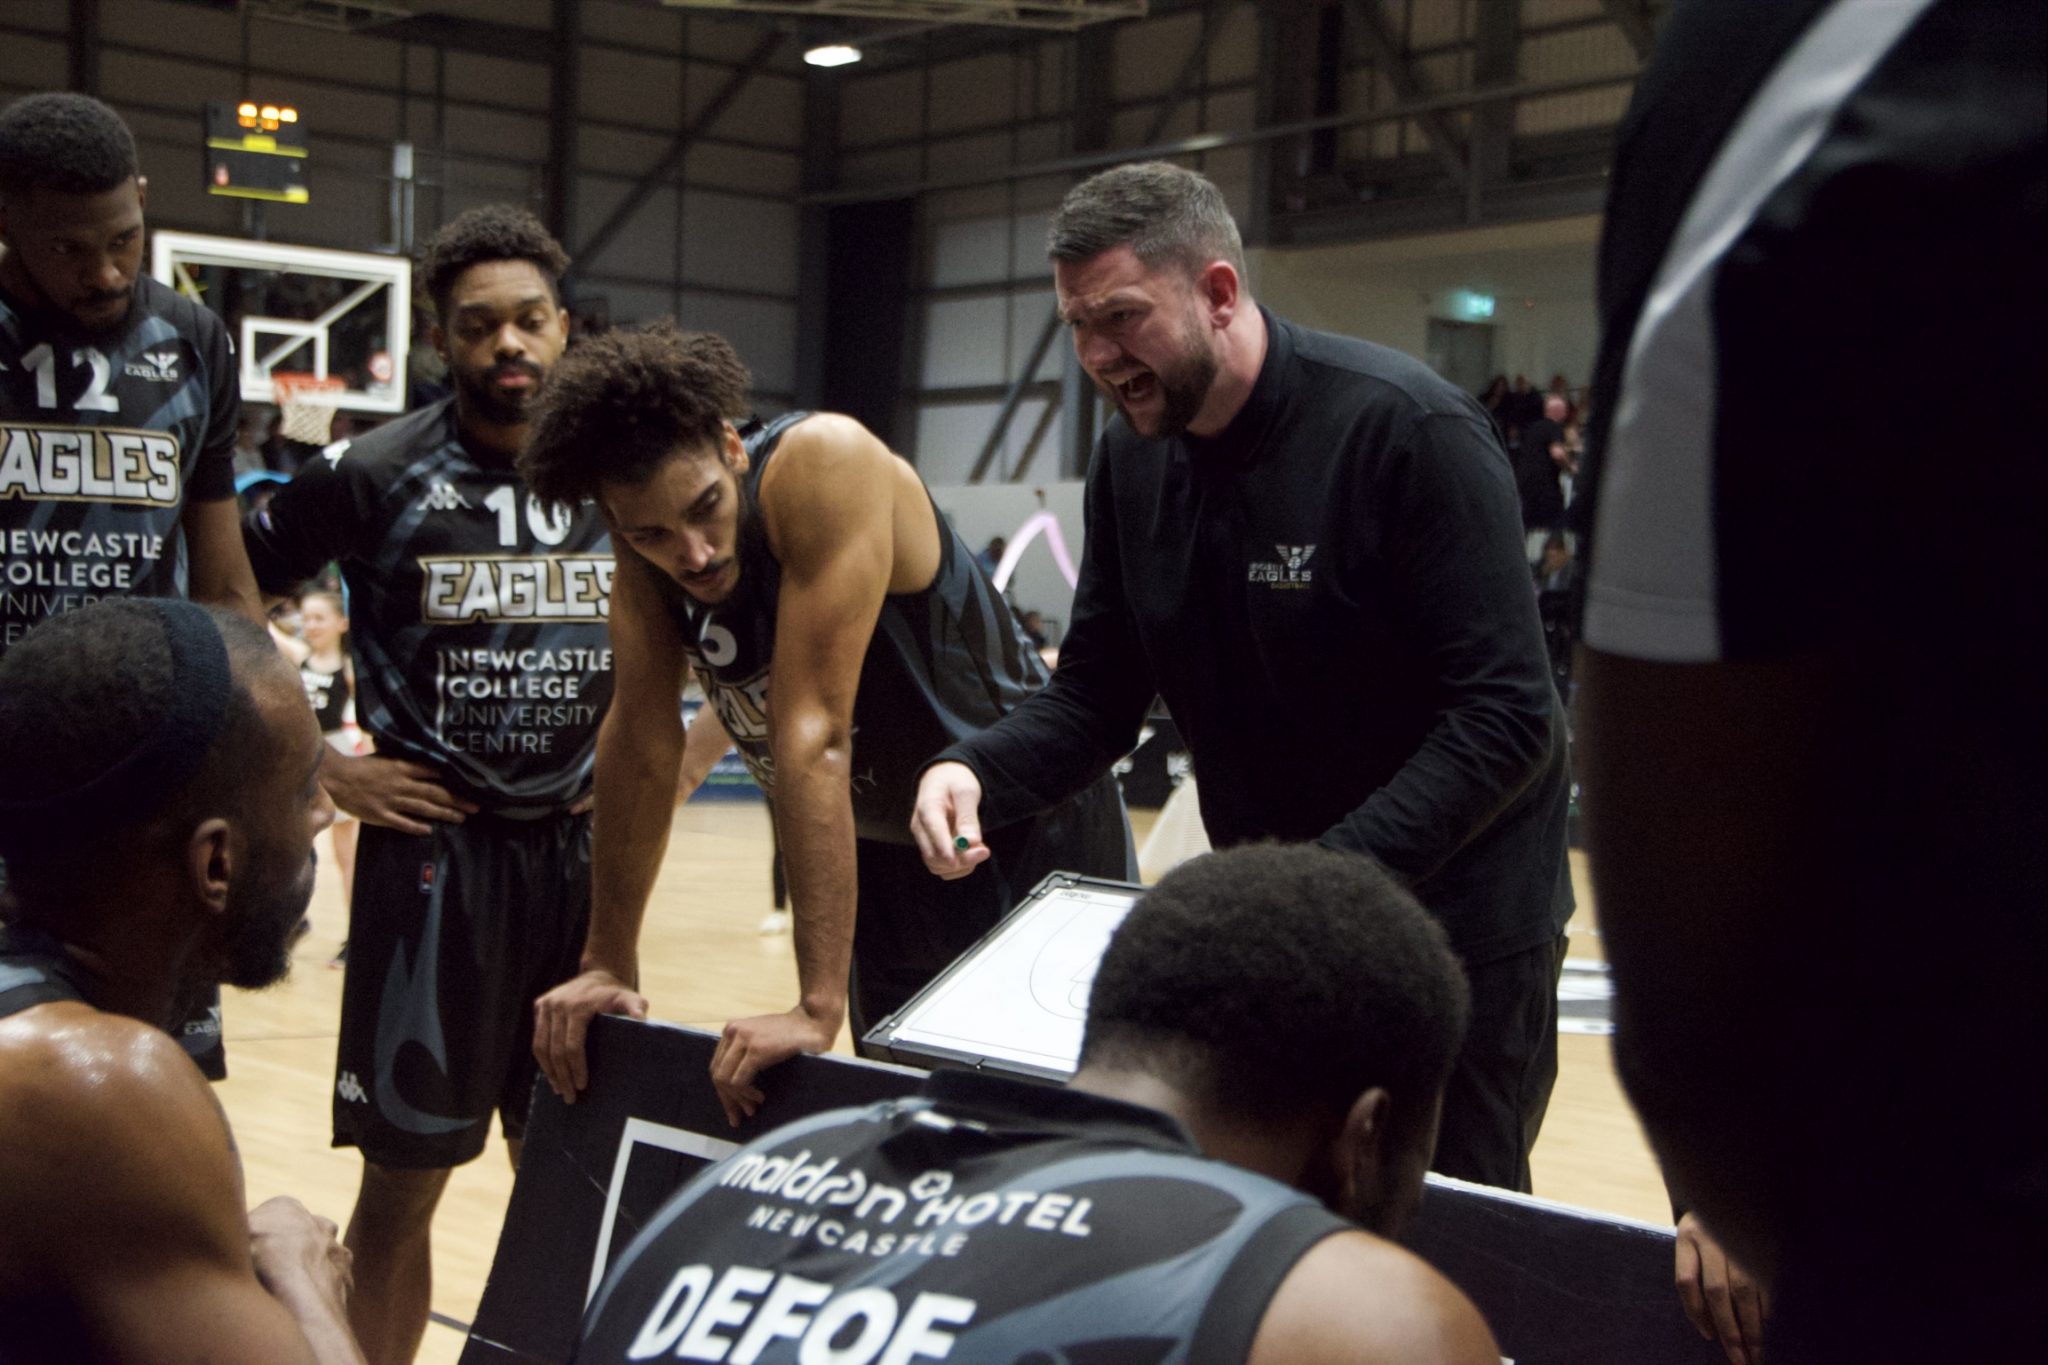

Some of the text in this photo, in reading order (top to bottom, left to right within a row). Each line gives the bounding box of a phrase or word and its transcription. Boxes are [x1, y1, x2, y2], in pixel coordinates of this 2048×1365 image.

[20, 343, 120, 413] 12
[484, 485, 572, 546] 10
[0, 561, 131, 588] OLLEGE
[1248, 570, 1312, 582] EAGLES
[449, 649, 613, 672] NEWCASTLE
[448, 675, 579, 699] COLLEGE
[450, 705, 597, 727] UNIVERSITY
[449, 732, 555, 753] CENTRE
[720, 1150, 1093, 1237] maldron HOTEL
[747, 1204, 969, 1257] NEWCASTLE
